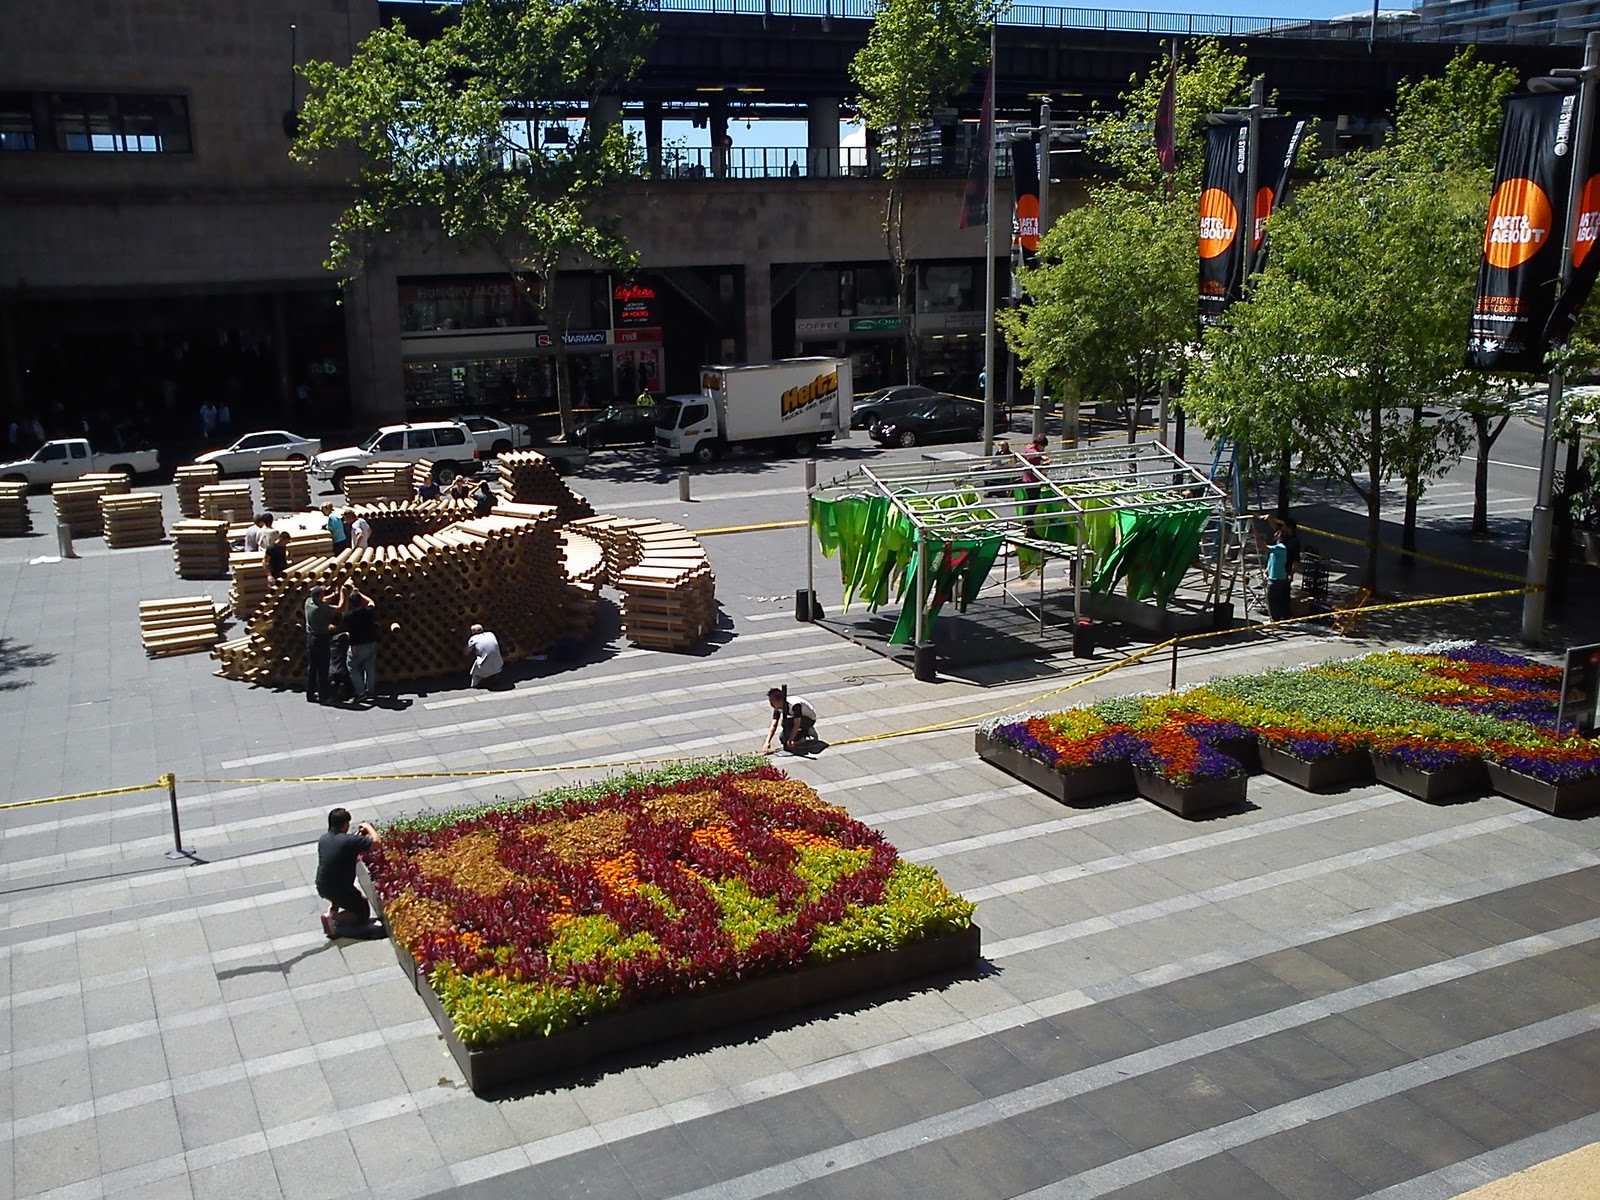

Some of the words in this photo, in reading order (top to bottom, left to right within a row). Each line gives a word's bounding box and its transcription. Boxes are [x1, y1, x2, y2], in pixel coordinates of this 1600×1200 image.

[1200, 228, 1234, 240] ABOUT
[1484, 296, 1520, 305] SEPTEMR
[797, 321, 839, 331] COFFEE
[781, 371, 839, 418] Hertz
